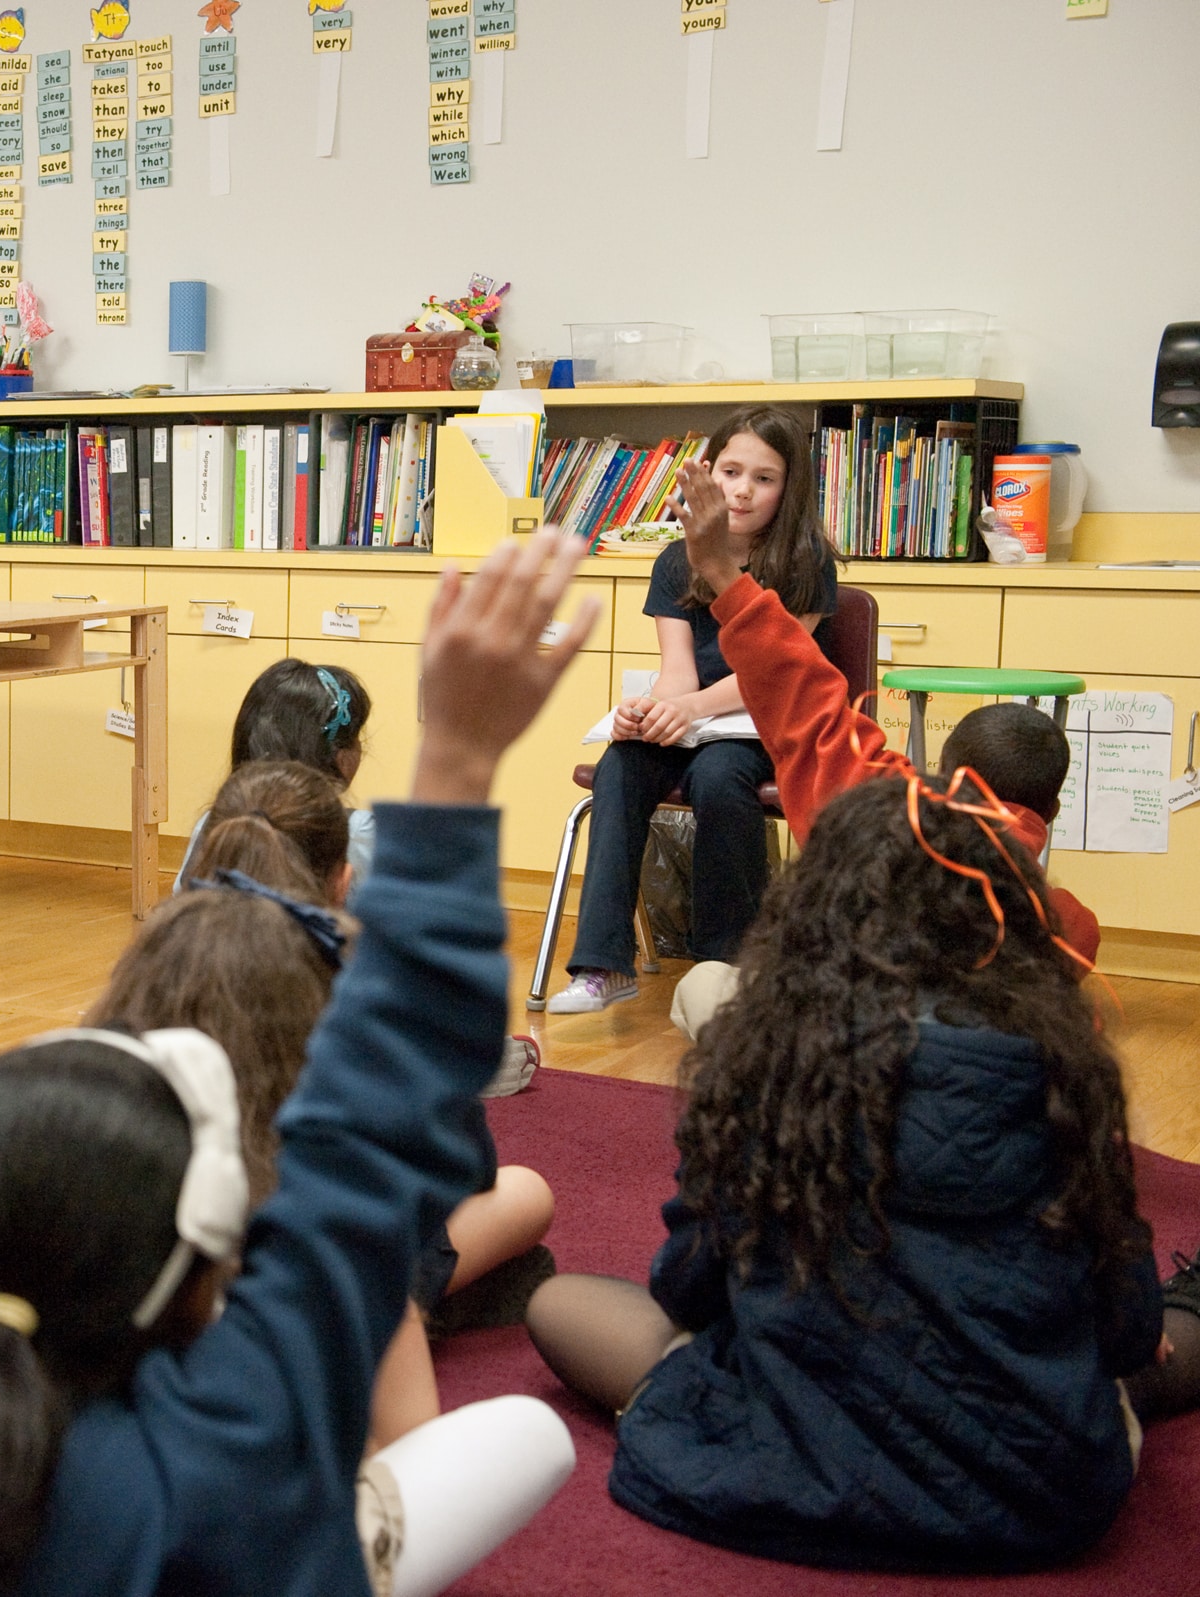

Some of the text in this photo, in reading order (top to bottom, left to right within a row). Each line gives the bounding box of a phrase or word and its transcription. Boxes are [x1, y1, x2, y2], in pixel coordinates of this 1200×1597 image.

[431, 2, 468, 15] waved
[483, 1, 505, 13] why
[321, 17, 343, 28] very
[480, 20, 510, 32] when
[683, 17, 721, 33] young
[430, 23, 465, 38] went
[139, 41, 168, 52] touch
[205, 41, 229, 52] until
[316, 37, 347, 50] very
[479, 39, 510, 50] willing
[85, 47, 134, 60] Tatyana
[431, 46, 467, 59] winter
[45, 58, 61, 67] sea
[146, 60, 162, 70] too
[208, 61, 226, 72] use
[96, 66, 125, 76] Tatiana
[436, 66, 461, 78] with
[44, 74, 60, 85] she
[201, 80, 233, 91] under
[92, 83, 126, 94] takes
[147, 80, 160, 92] to
[43, 91, 64, 102] sleep
[436, 88, 464, 104] why
[95, 104, 125, 116] than
[142, 103, 166, 115] two
[203, 99, 230, 113] unit
[42, 107, 66, 119] snow
[433, 109, 463, 122] while
[41, 122, 67, 135] should
[95, 125, 124, 140] they
[146, 124, 162, 136] try
[432, 129, 465, 141] which
[50, 142, 60, 150] so
[94, 146, 123, 158] then
[137, 140, 170, 152] together
[142, 156, 164, 167] that
[432, 150, 466, 163] wrong
[41, 160, 67, 172] save
[100, 164, 119, 175] tell
[140, 174, 166, 185] them
[434, 169, 467, 181] Week
[102, 185, 120, 194] ten
[0, 208, 14, 216] sea
[98, 202, 123, 212] three
[98, 219, 124, 230] things
[100, 237, 118, 250] try
[100, 258, 120, 270] the
[0, 280, 10, 288] so
[97, 280, 124, 290] there
[102, 296, 120, 306] told
[269, 437, 278, 541] Common Core State Standards
[996, 483, 1026, 498] CLOROX
[217, 613, 239, 622] Index
[216, 624, 236, 633] Cards
[1103, 692, 1156, 720] Working
[1131, 744, 1150, 752] quiet
[1169, 790, 1193, 804] Cleaning
